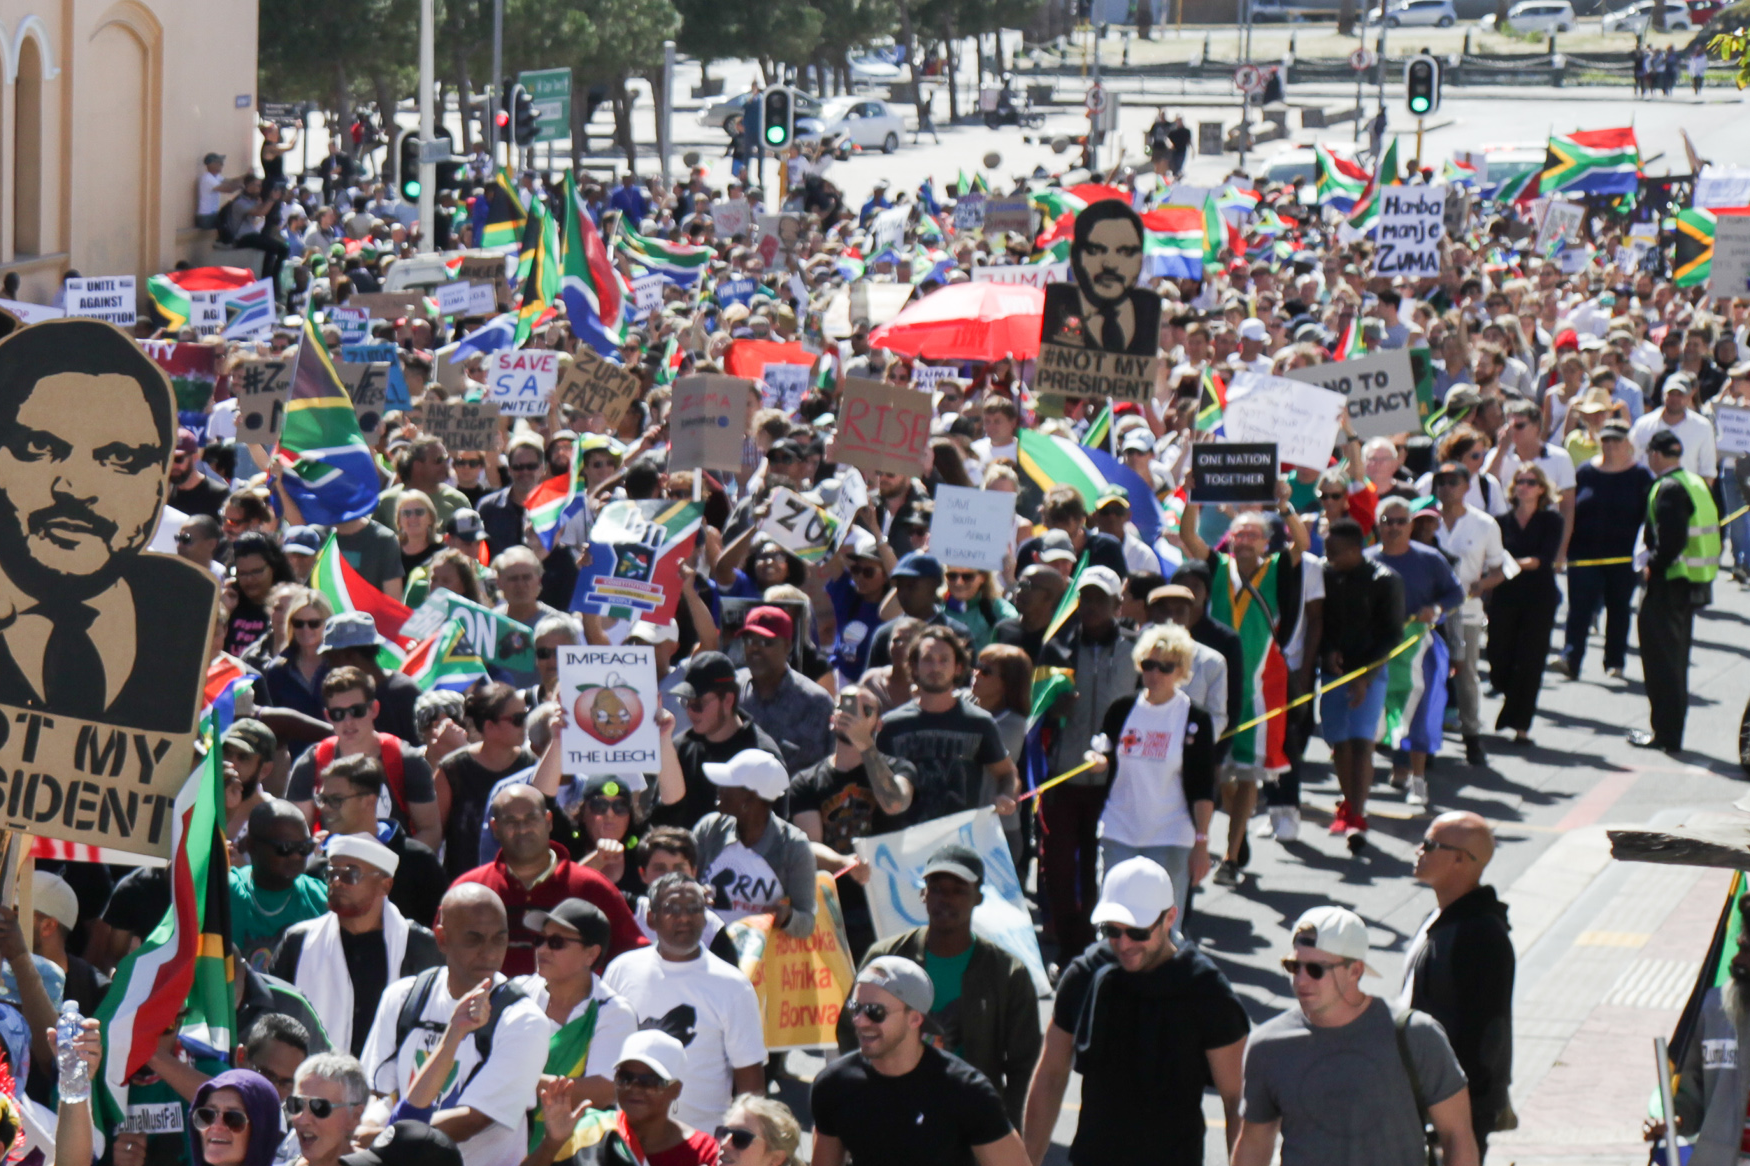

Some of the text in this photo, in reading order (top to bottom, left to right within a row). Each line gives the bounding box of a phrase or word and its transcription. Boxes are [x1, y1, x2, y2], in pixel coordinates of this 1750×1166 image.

[1378, 244, 1438, 273] ZUMA
[87, 280, 116, 292] UNITE
[79, 296, 123, 309] AGAINST
[499, 353, 554, 373] SAVE
[1114, 355, 1149, 377] MY
[1036, 368, 1155, 400] PRESIDENT
[1358, 371, 1389, 389] TO
[843, 397, 929, 454] RISE
[1199, 453, 1272, 466] ONE NATION
[1203, 473, 1265, 485] TOGETHER
[603, 578, 652, 592] CONSTITUTION
[566, 652, 648, 667] IMPEACH
[73, 724, 172, 786] MY
[569, 749, 656, 764] THE LEECH
[781, 961, 833, 993] Afrika
[779, 1000, 841, 1029] Borwa
